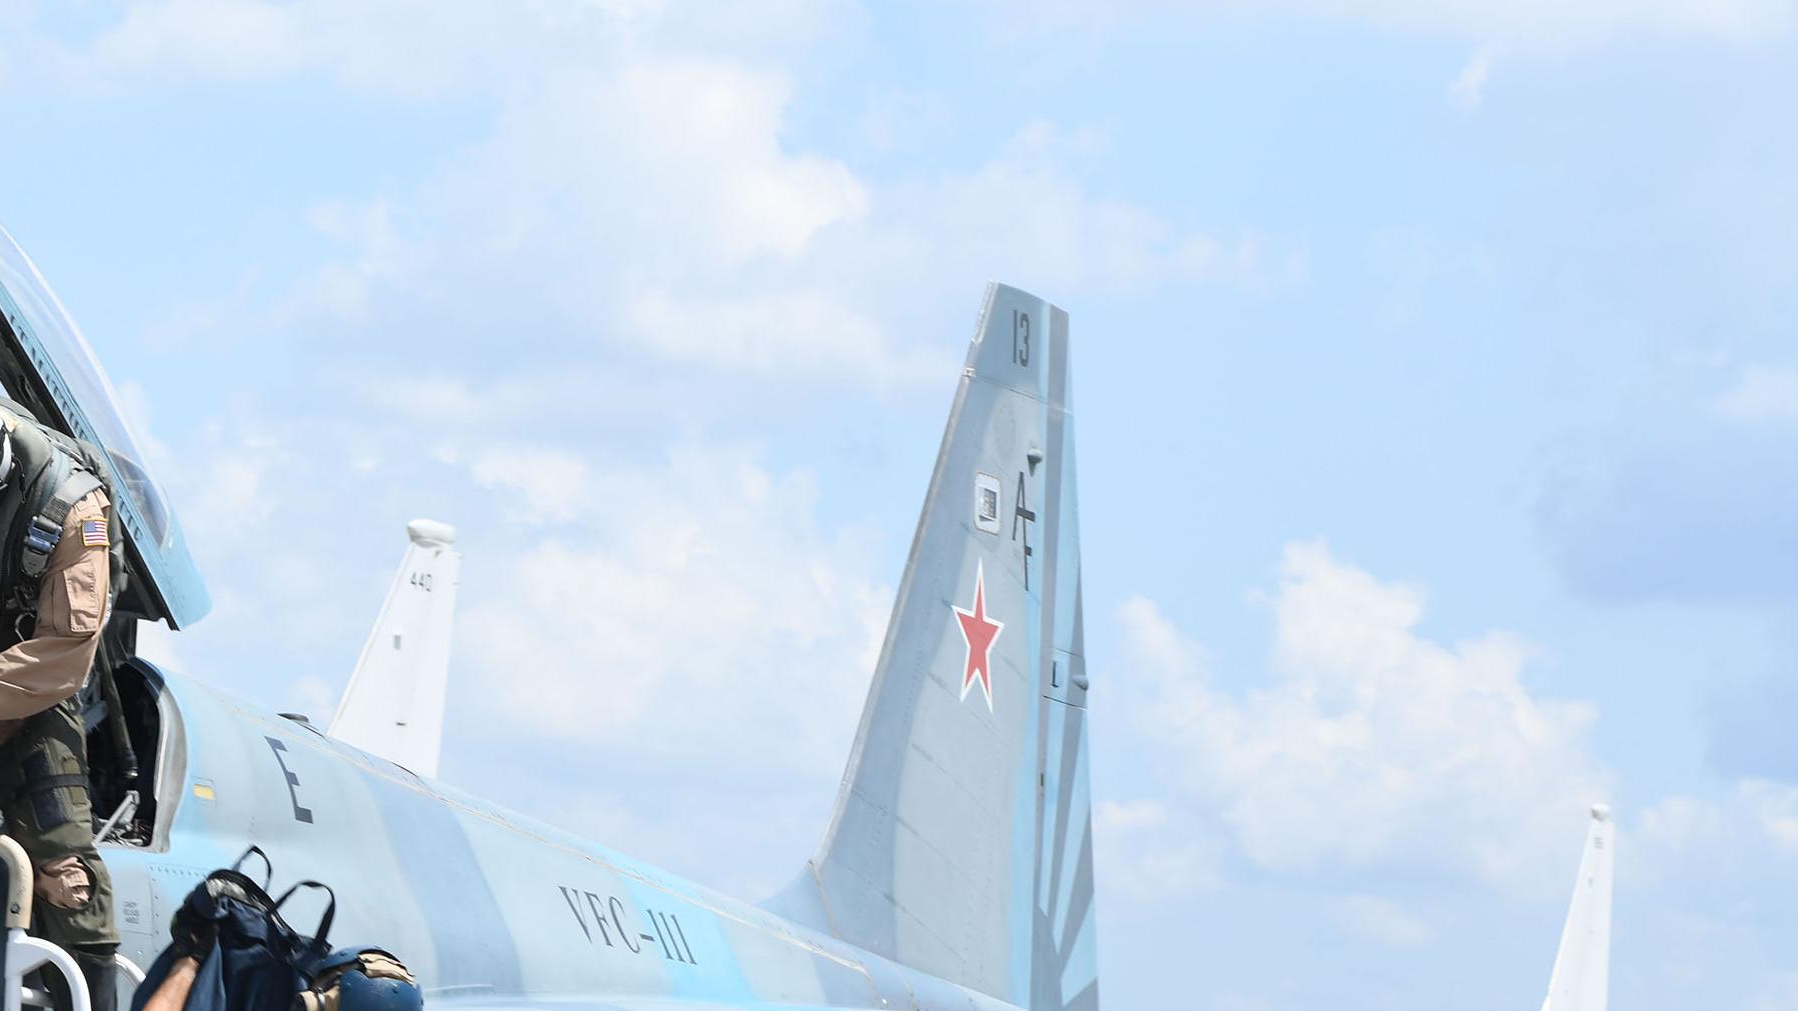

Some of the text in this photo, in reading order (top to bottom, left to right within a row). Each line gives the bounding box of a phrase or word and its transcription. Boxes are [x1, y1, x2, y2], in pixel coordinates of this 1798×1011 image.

[1012, 309, 1030, 368] 13
[410, 571, 433, 592] 440
[264, 736, 314, 824] E
